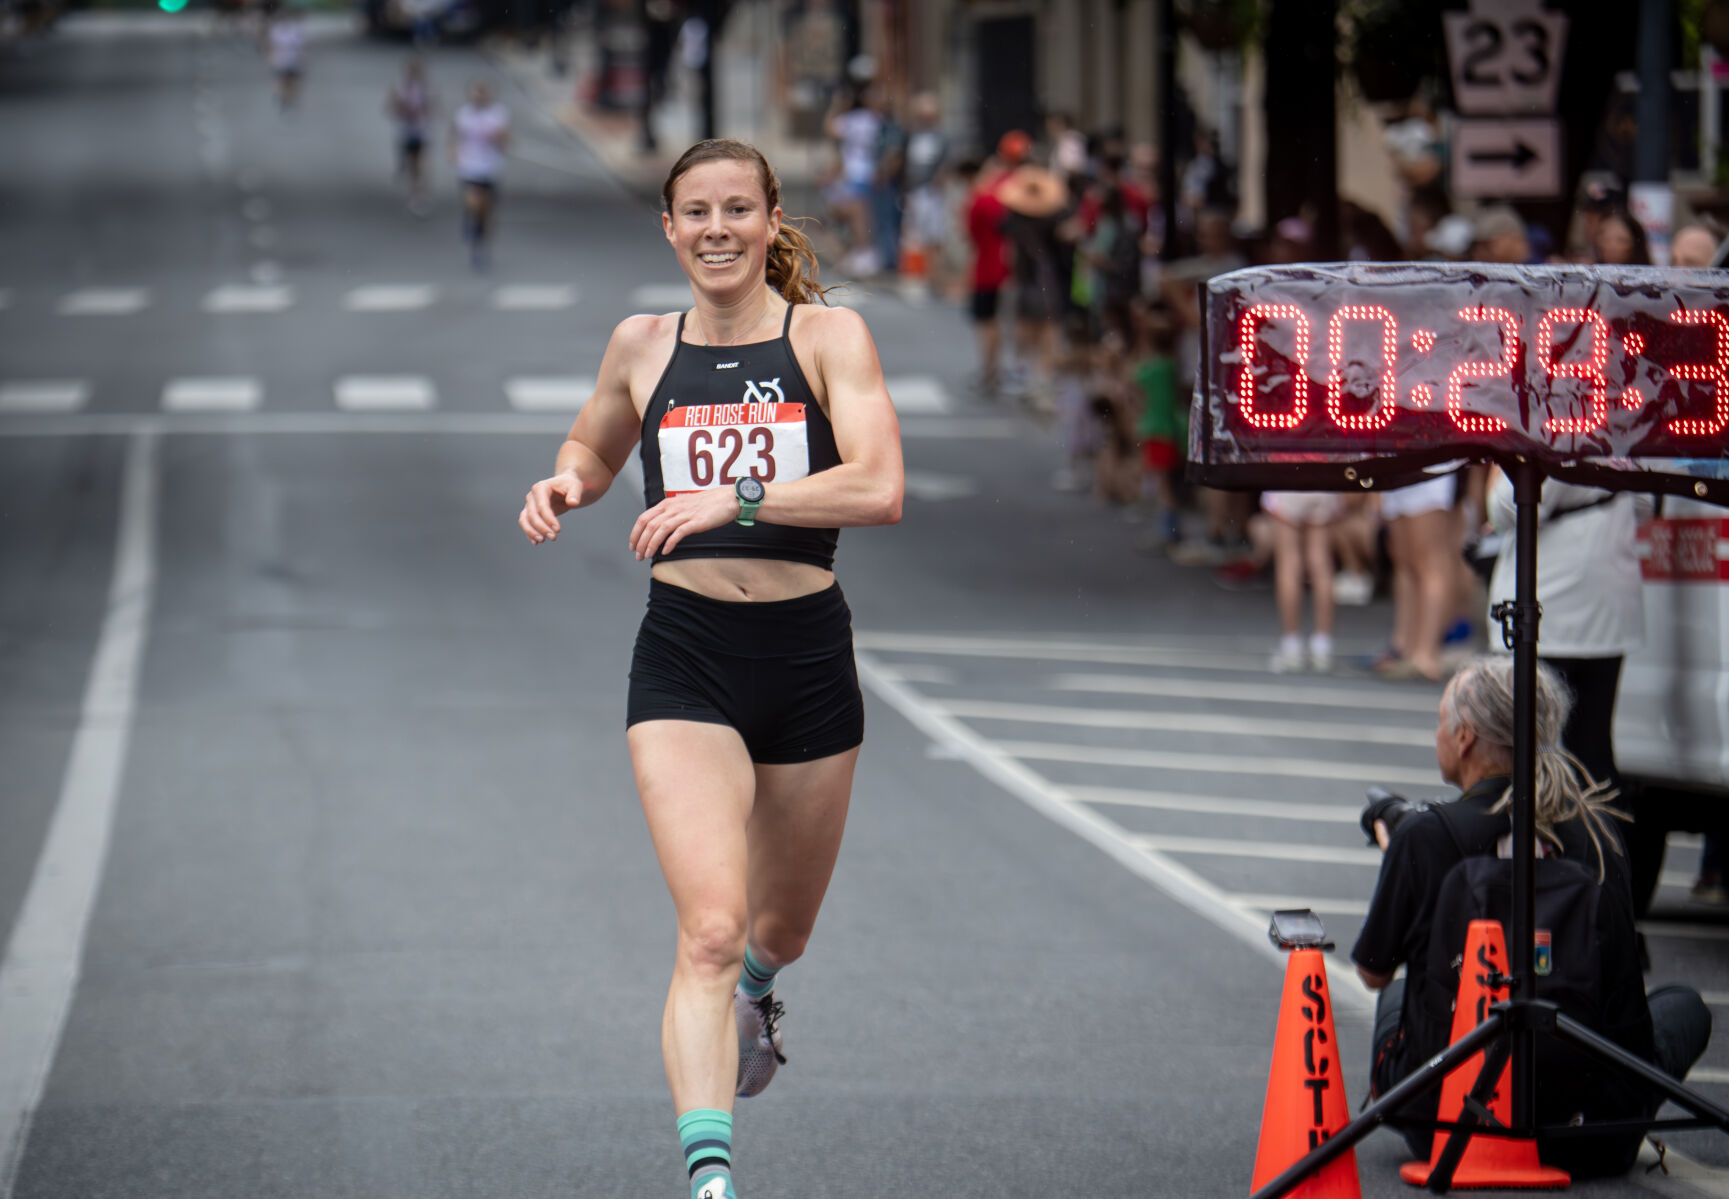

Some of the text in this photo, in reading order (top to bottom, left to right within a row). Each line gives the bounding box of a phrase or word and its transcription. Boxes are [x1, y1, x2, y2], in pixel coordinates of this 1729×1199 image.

[1463, 20, 1549, 86] 23
[684, 402, 777, 427] RED ROSE RUN
[687, 426, 777, 487] 623
